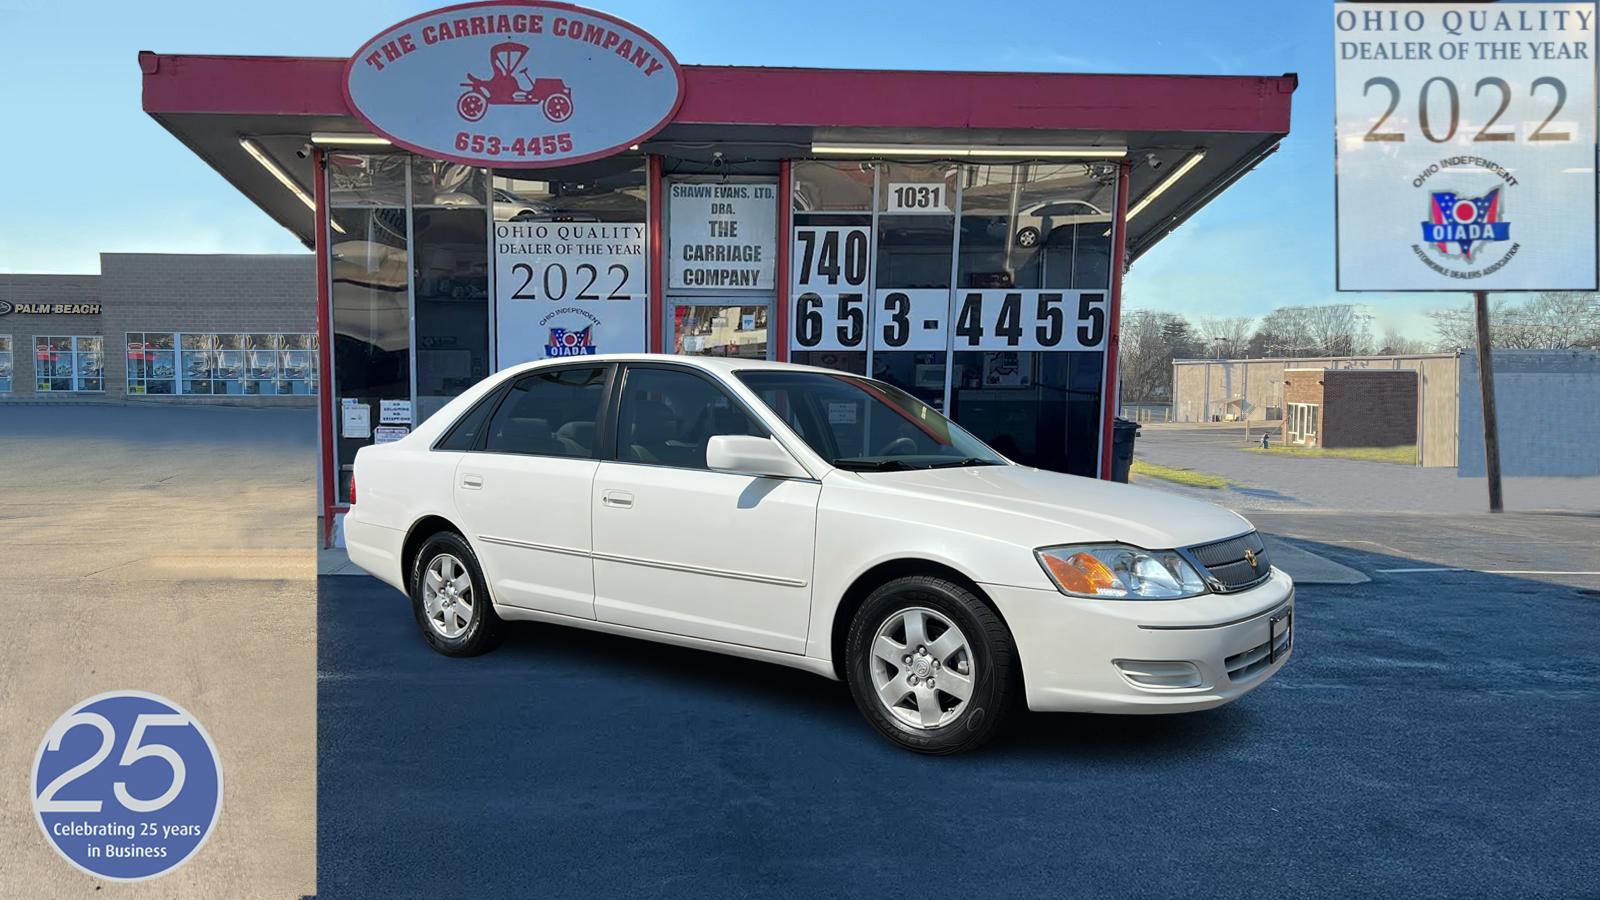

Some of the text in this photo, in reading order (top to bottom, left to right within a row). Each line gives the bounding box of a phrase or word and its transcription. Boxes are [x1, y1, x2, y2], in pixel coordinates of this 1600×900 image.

[1336, 10, 1593, 35] OHIO QUALITY
[366, 14, 664, 77] THE CARRIAGE COMPANY
[1340, 41, 1589, 60] DEALER OF THE YEAR
[1362, 76, 1571, 144] 2022
[454, 131, 574, 157] 653-4455
[1412, 155, 1519, 188] OHIO INDEPENDENT
[672, 185, 712, 199] SHAWN
[754, 187, 775, 200] LTD.
[894, 186, 941, 209] 1031
[711, 203, 736, 215] DBA.
[497, 226, 644, 241] OHIO QUALITY
[708, 220, 738, 238] THE
[1432, 224, 1496, 241] OIADA
[500, 243, 641, 255] DEALER OF THE YEAR
[683, 244, 762, 263] CARRIAGE
[796, 230, 868, 287] 740
[1411, 242, 1521, 280] AUTOMOBILE DEALERS ASSOCIATION
[511, 262, 631, 301] 2022
[683, 268, 760, 287] COMPANY
[14, 303, 101, 314] PALM BEACH
[555, 307, 601, 326] INDEPENDENT
[551, 346, 588, 356] OIADA
